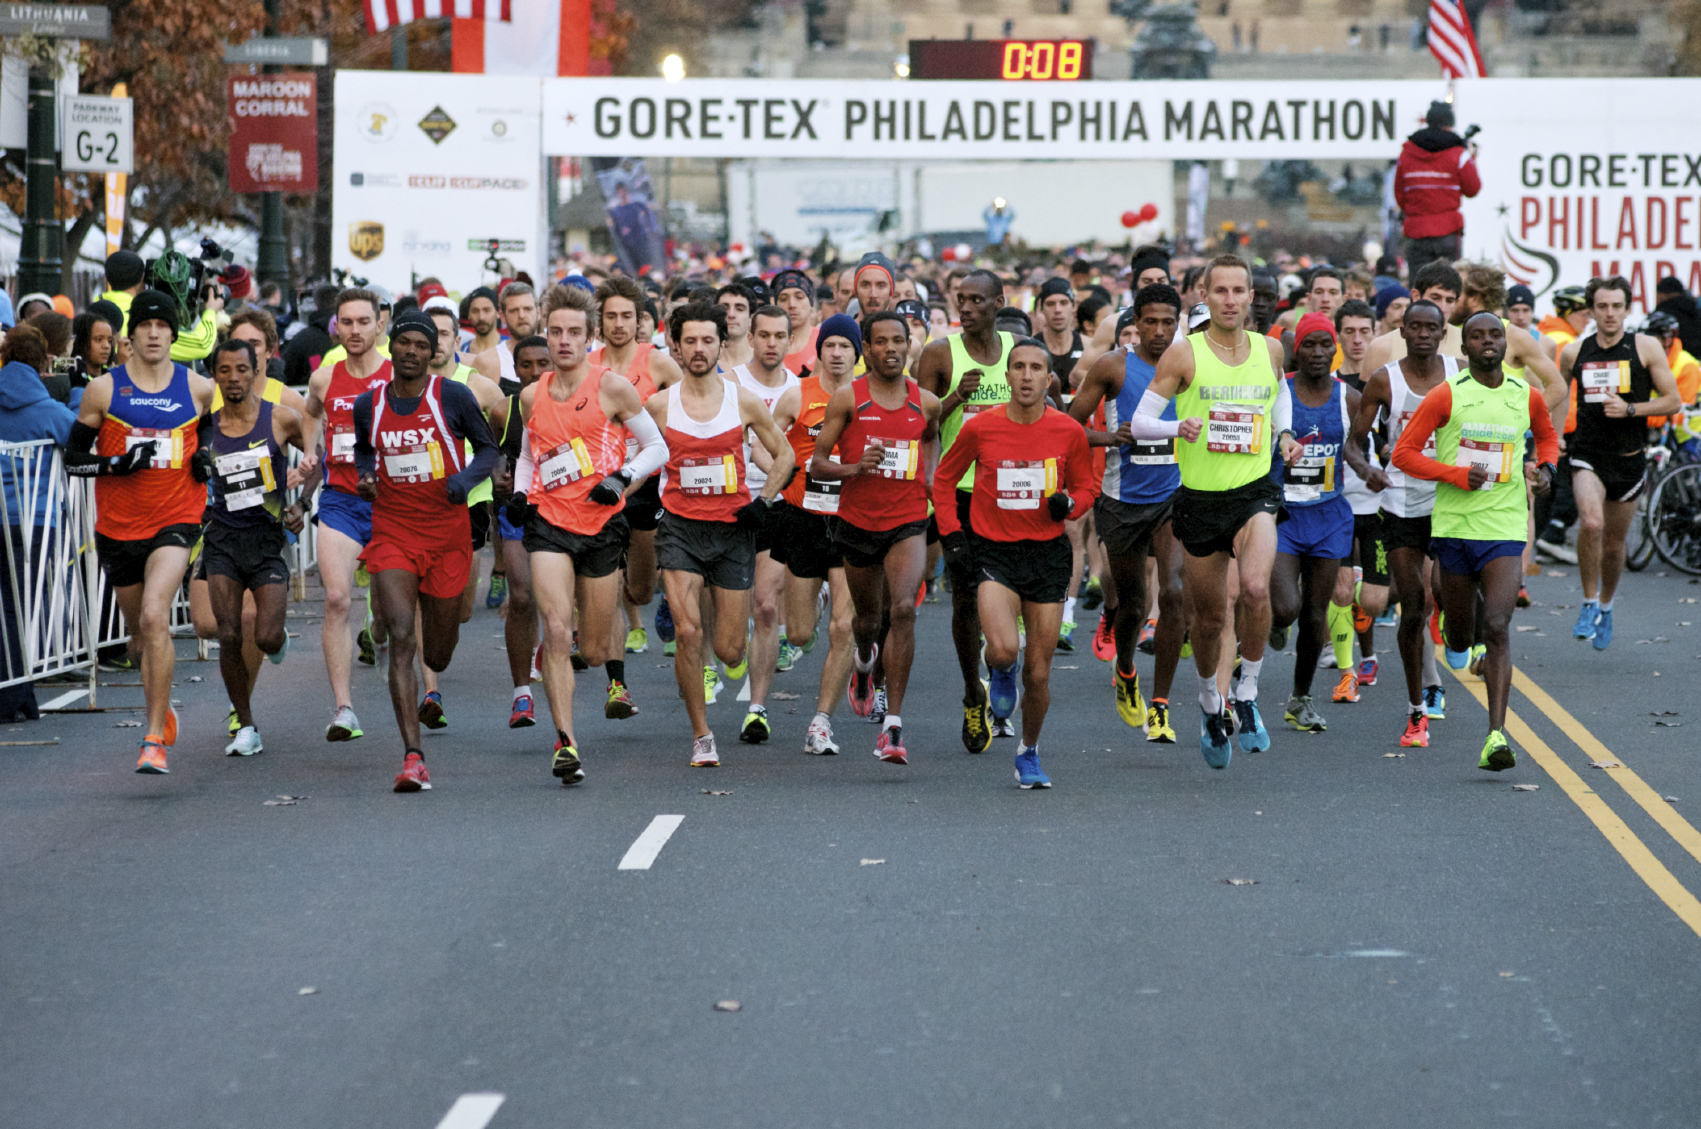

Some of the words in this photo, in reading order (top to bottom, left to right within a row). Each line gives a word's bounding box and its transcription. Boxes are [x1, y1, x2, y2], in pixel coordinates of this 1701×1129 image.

[11, 6, 88, 21] LITHUANIA
[1002, 41, 1083, 79] 0:08
[233, 81, 311, 97] MAROON
[73, 103, 120, 112] PARKWAY
[235, 100, 309, 116] CORRAL
[72, 115, 122, 125] LOCATION
[844, 99, 1148, 141] PHILADELPHIA
[1164, 100, 1395, 141] MARATHON
[77, 130, 118, 164] G-2
[1521, 197, 1701, 250] PHILADE
[1199, 385, 1271, 400] BERMUDA
[130, 397, 171, 407] saucony
[1209, 423, 1253, 433] CHRISTOPHER
[1461, 422, 1518, 434] MARATHON
[1461, 429, 1516, 440] guide.com
[381, 427, 436, 448] WSX
[1303, 443, 1340, 456] EPOT
